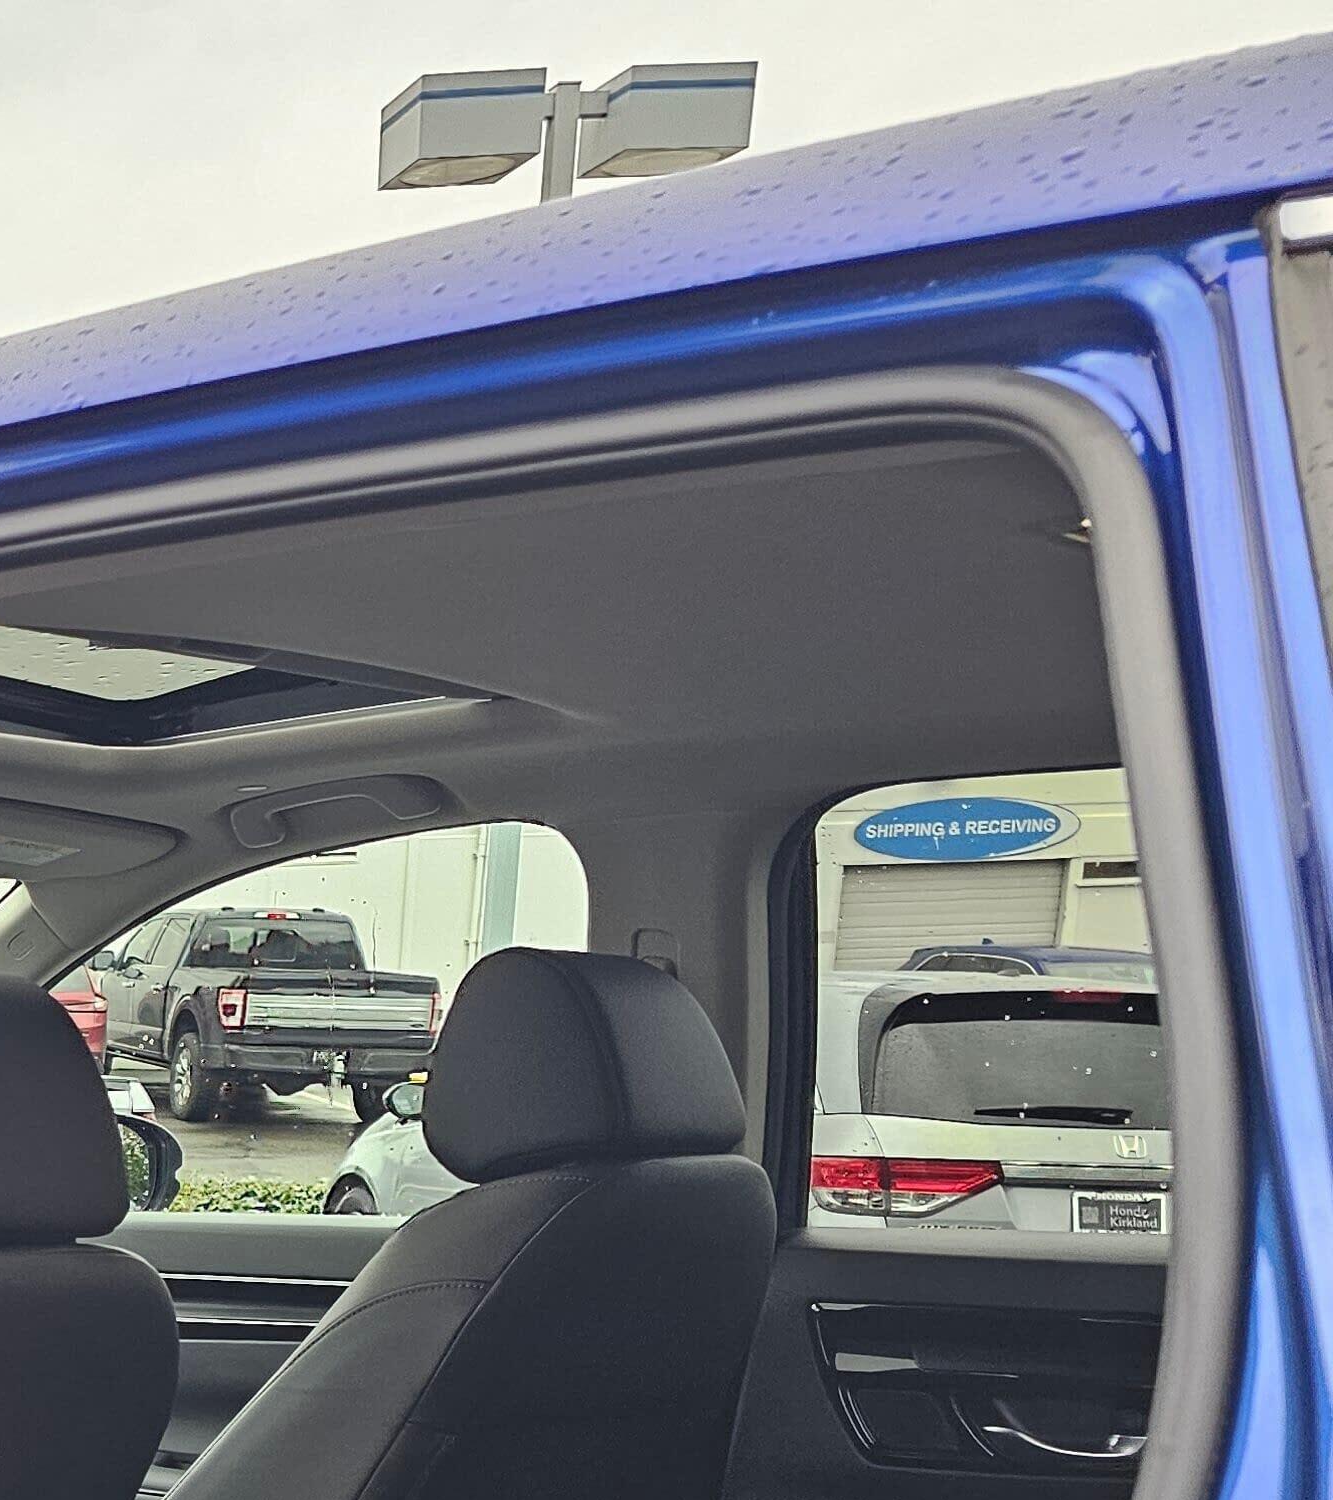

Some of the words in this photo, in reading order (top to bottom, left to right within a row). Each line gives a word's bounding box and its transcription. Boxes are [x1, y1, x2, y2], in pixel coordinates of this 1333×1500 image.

[865, 821, 945, 839] SHIPPING
[948, 821, 961, 836] &
[965, 818, 1056, 835] RECEIVING
[1109, 1217, 1158, 1229] Kirkland
